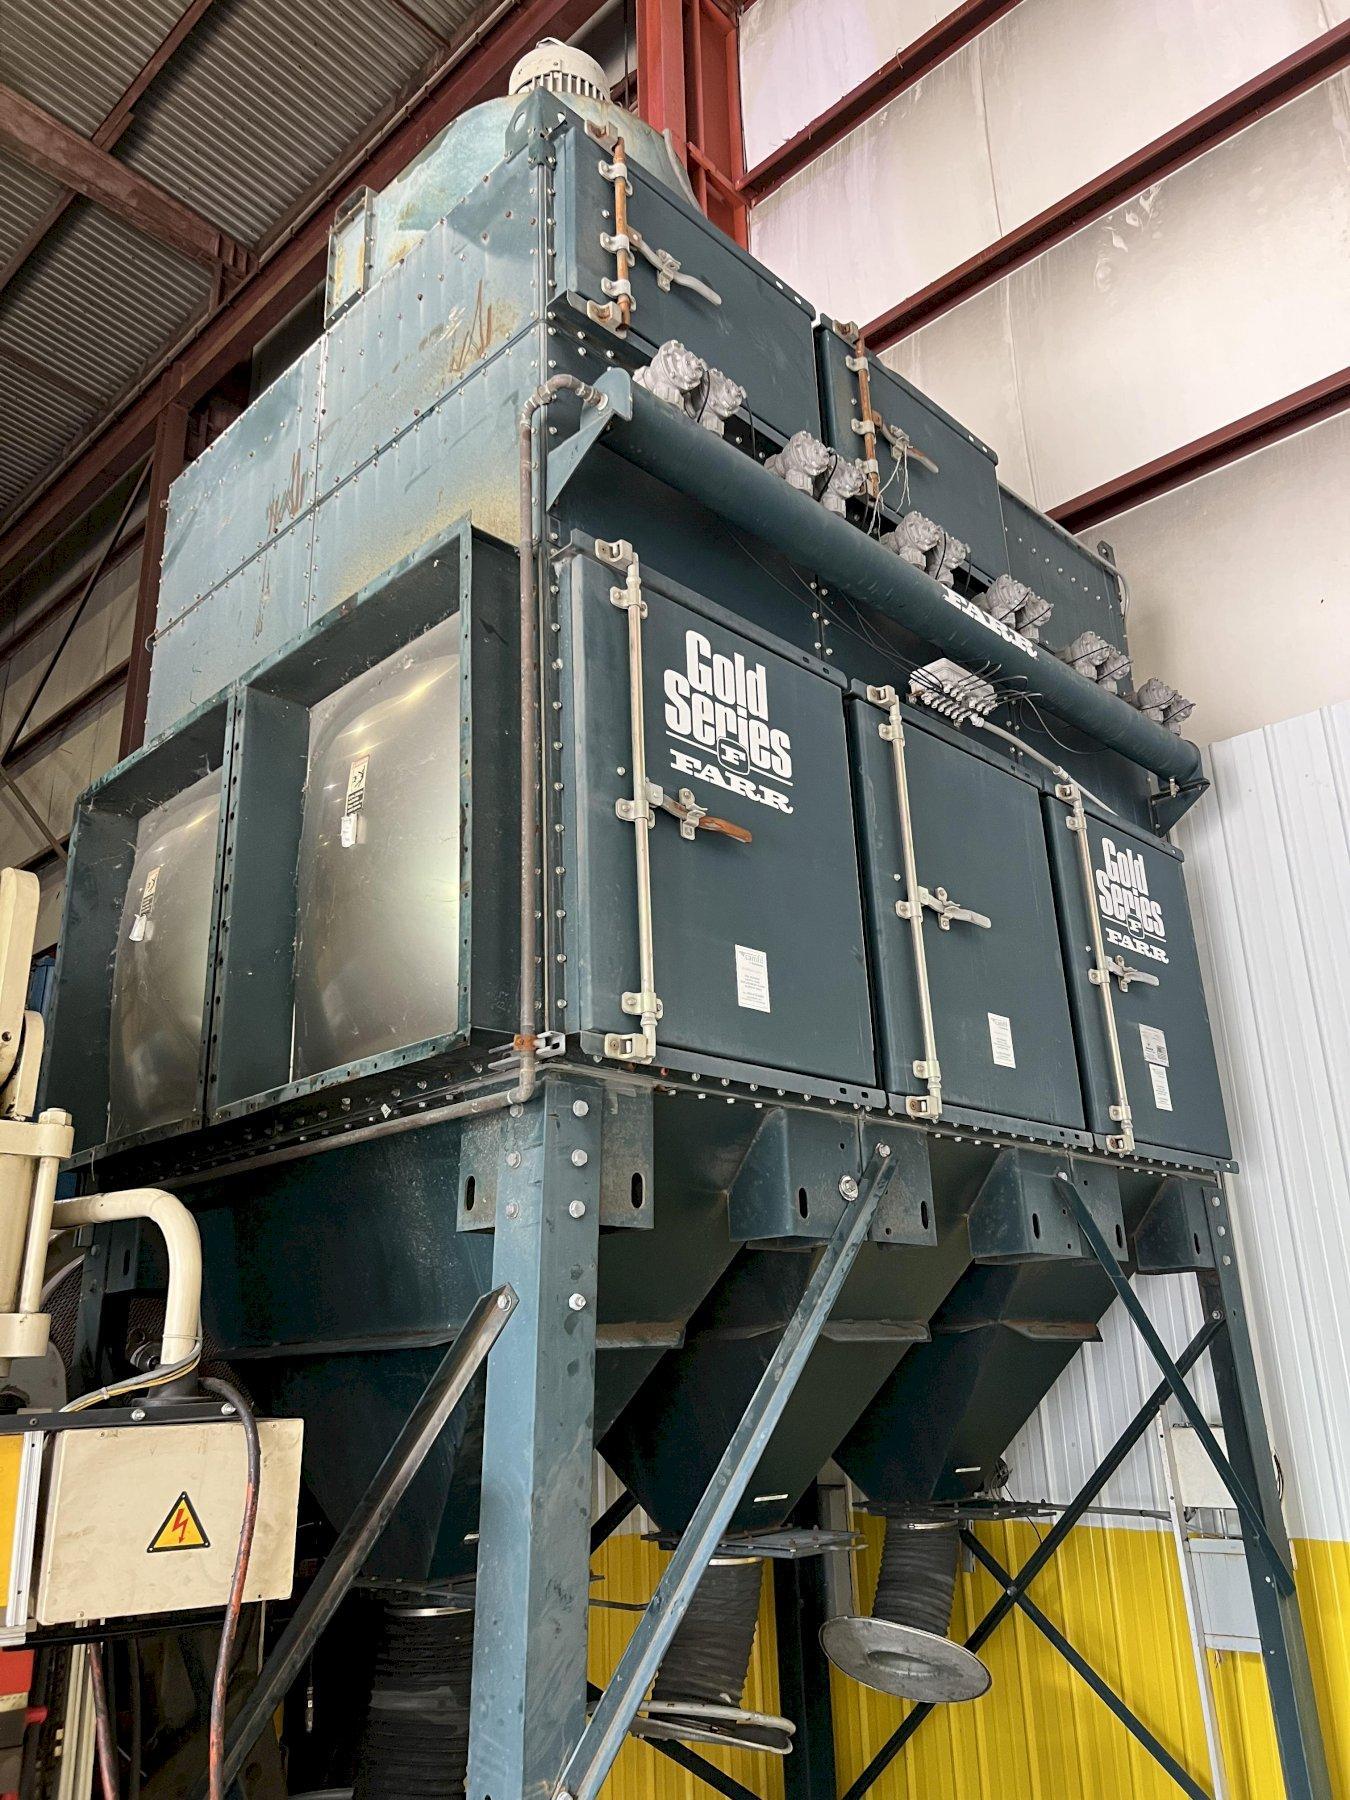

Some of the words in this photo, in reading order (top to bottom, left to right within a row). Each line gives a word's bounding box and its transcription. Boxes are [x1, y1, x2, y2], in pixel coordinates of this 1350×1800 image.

[941, 583, 1038, 659] FARR
[686, 630, 768, 721] Gold
[664, 669, 792, 778] Series
[721, 743, 746, 766] F
[670, 749, 793, 814] FARR
[1102, 837, 1149, 896] Gold
[1096, 869, 1165, 937] Series
[1105, 927, 1169, 964] FARR
